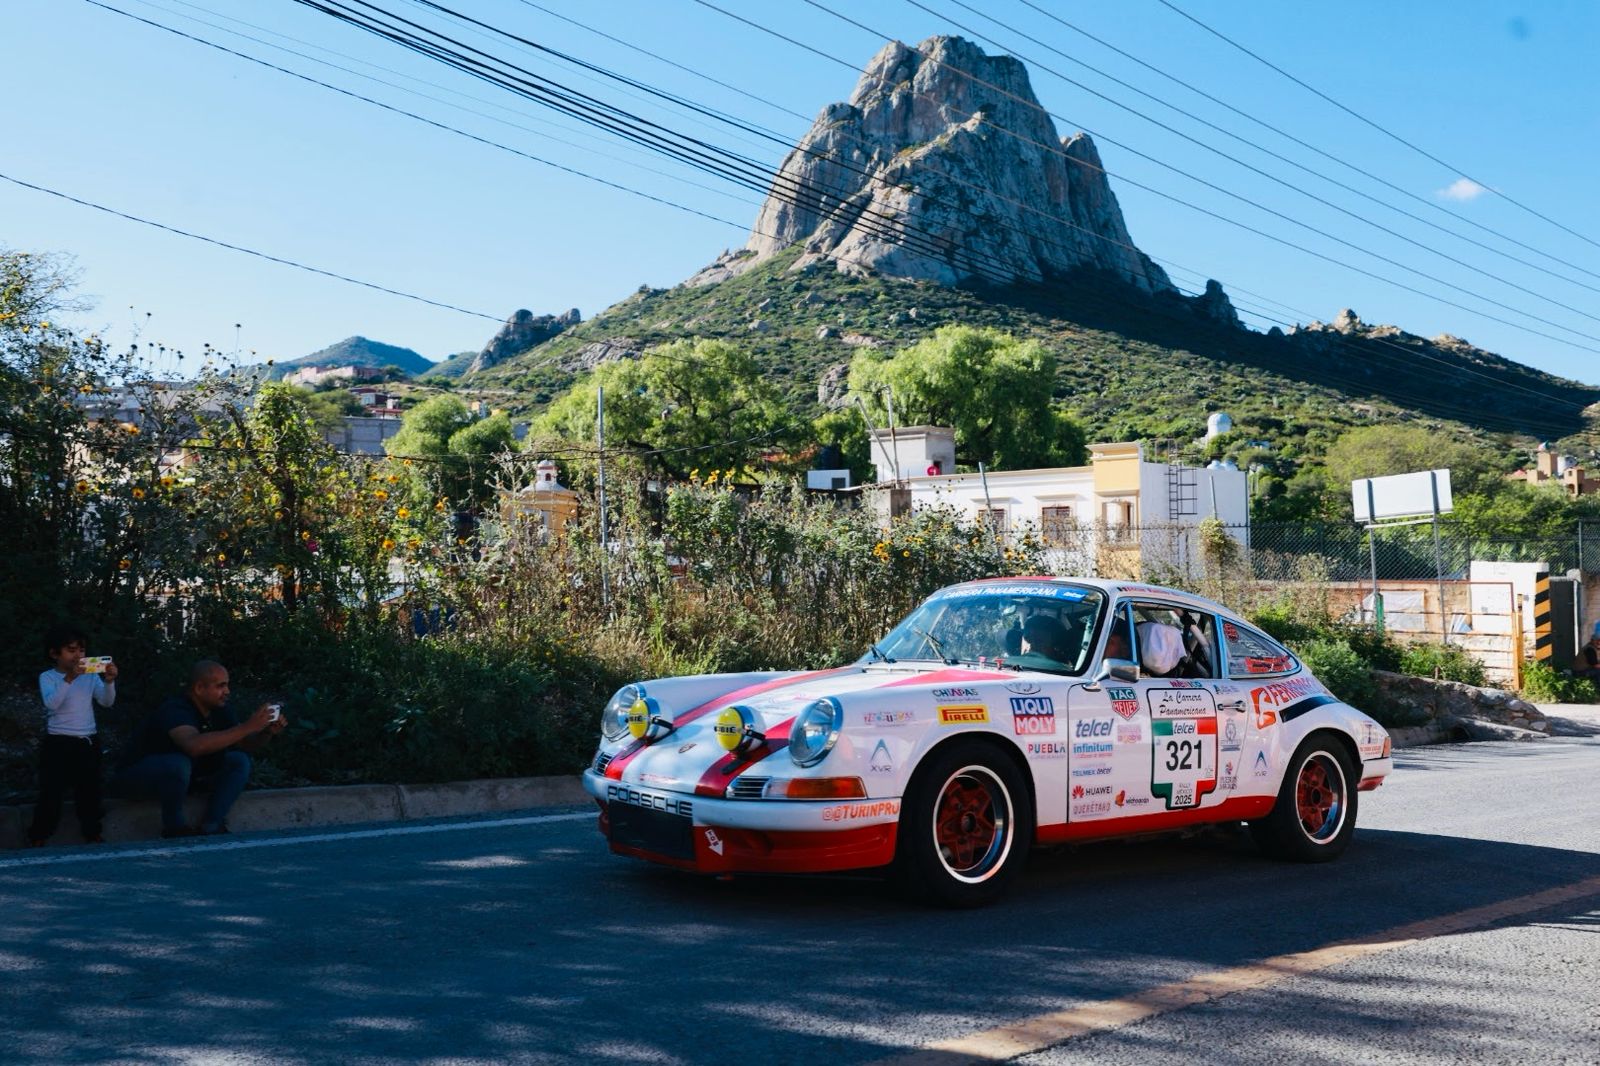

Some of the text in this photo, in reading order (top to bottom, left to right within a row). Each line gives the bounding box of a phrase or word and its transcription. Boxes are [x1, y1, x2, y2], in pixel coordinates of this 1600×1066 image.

[1110, 689, 1135, 700] TAG
[1162, 691, 1202, 704] La Carrera
[1012, 698, 1053, 715] LIQUI
[1112, 701, 1137, 717] HEUER
[1159, 704, 1207, 716] Panamericana
[941, 708, 985, 721] PIRELLI
[1015, 716, 1055, 734] MOLY
[1075, 718, 1114, 738] telcel
[1174, 722, 1196, 734] telcel
[1073, 742, 1113, 754] infinitum
[1166, 740, 1202, 771] 321
[1085, 786, 1113, 796] HUAWEI
[607, 785, 693, 817] PORSCHE
[1174, 794, 1193, 805] 2025
